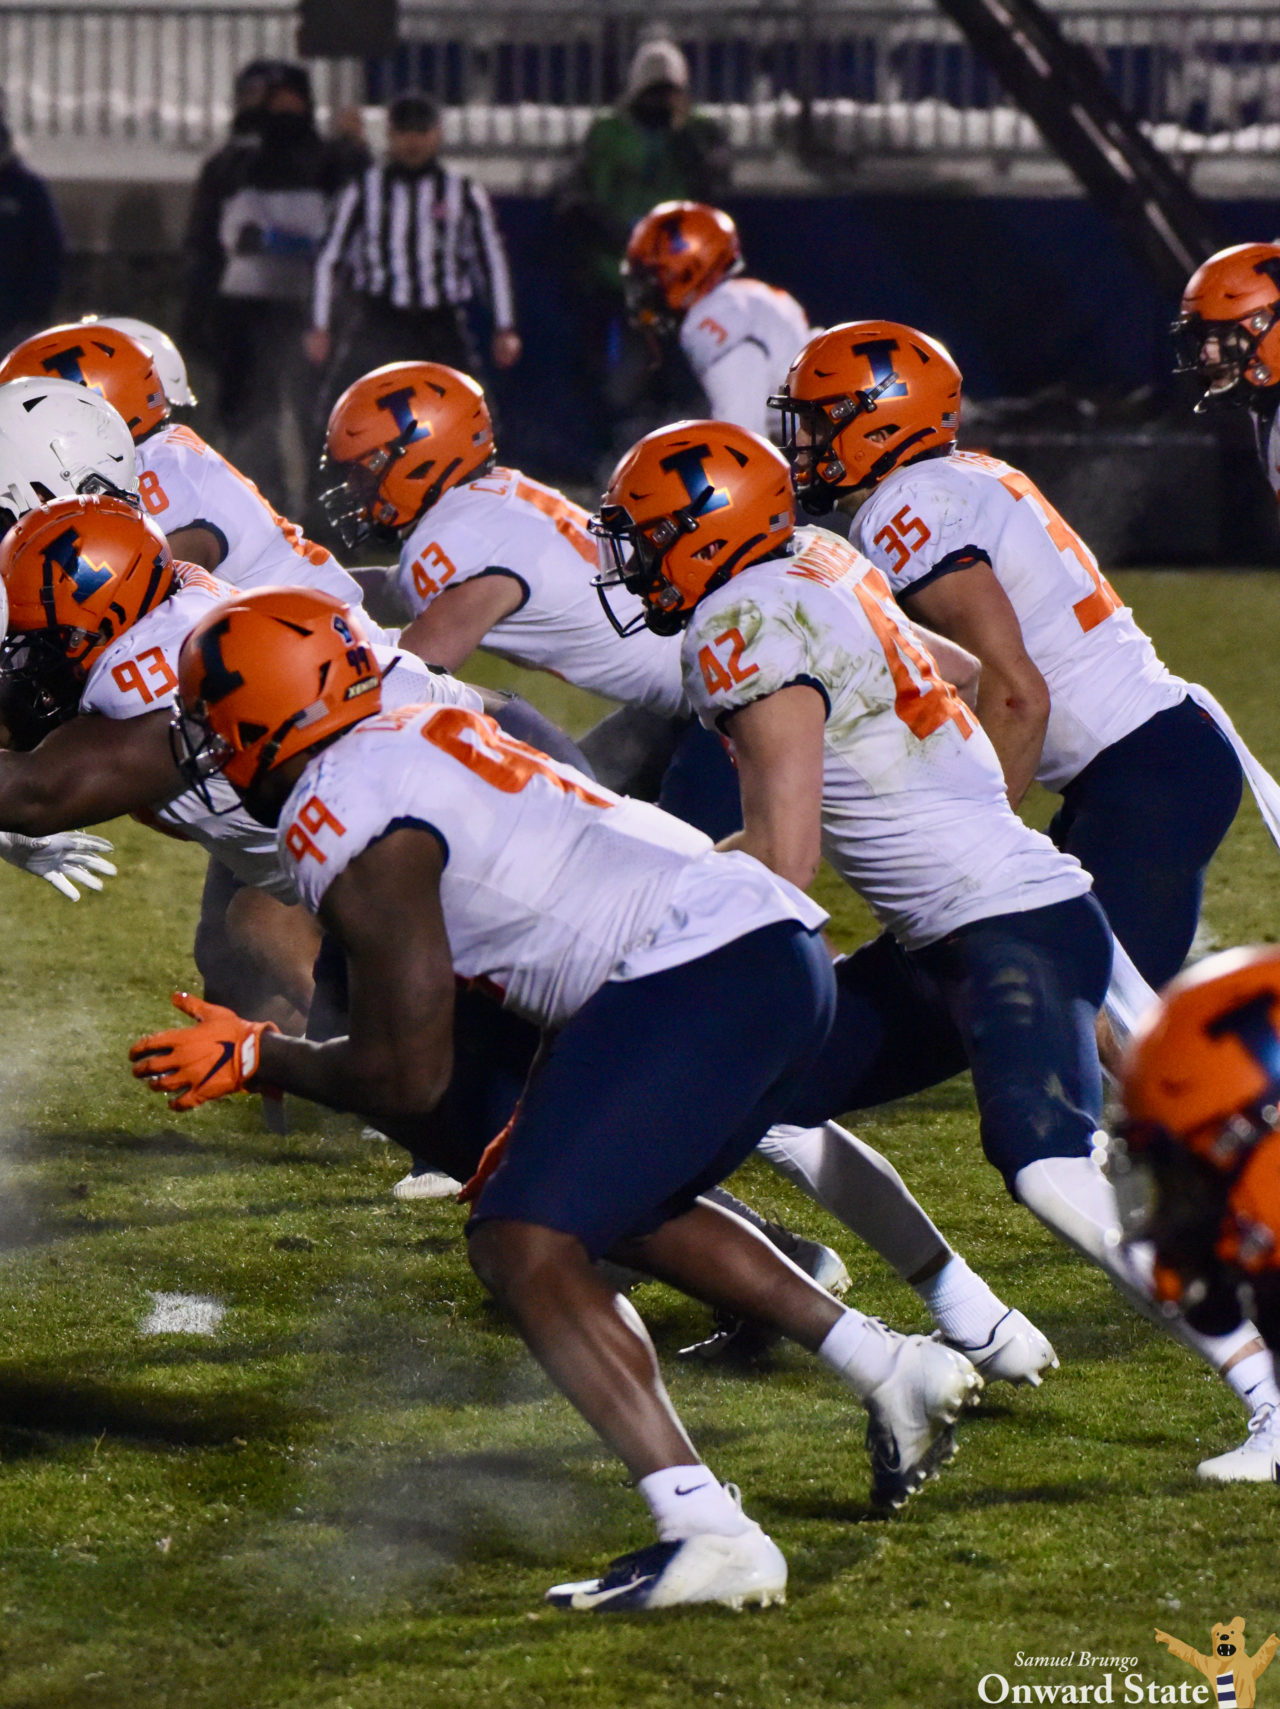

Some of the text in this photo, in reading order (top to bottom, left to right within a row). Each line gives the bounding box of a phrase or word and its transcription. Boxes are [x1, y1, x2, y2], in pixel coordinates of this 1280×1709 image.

[698, 316, 729, 348] 3
[872, 503, 933, 575] 35
[410, 541, 457, 600] 43
[111, 645, 180, 705] 93
[345, 645, 372, 676] 99
[697, 626, 760, 697] 42
[285, 795, 347, 865] 99
